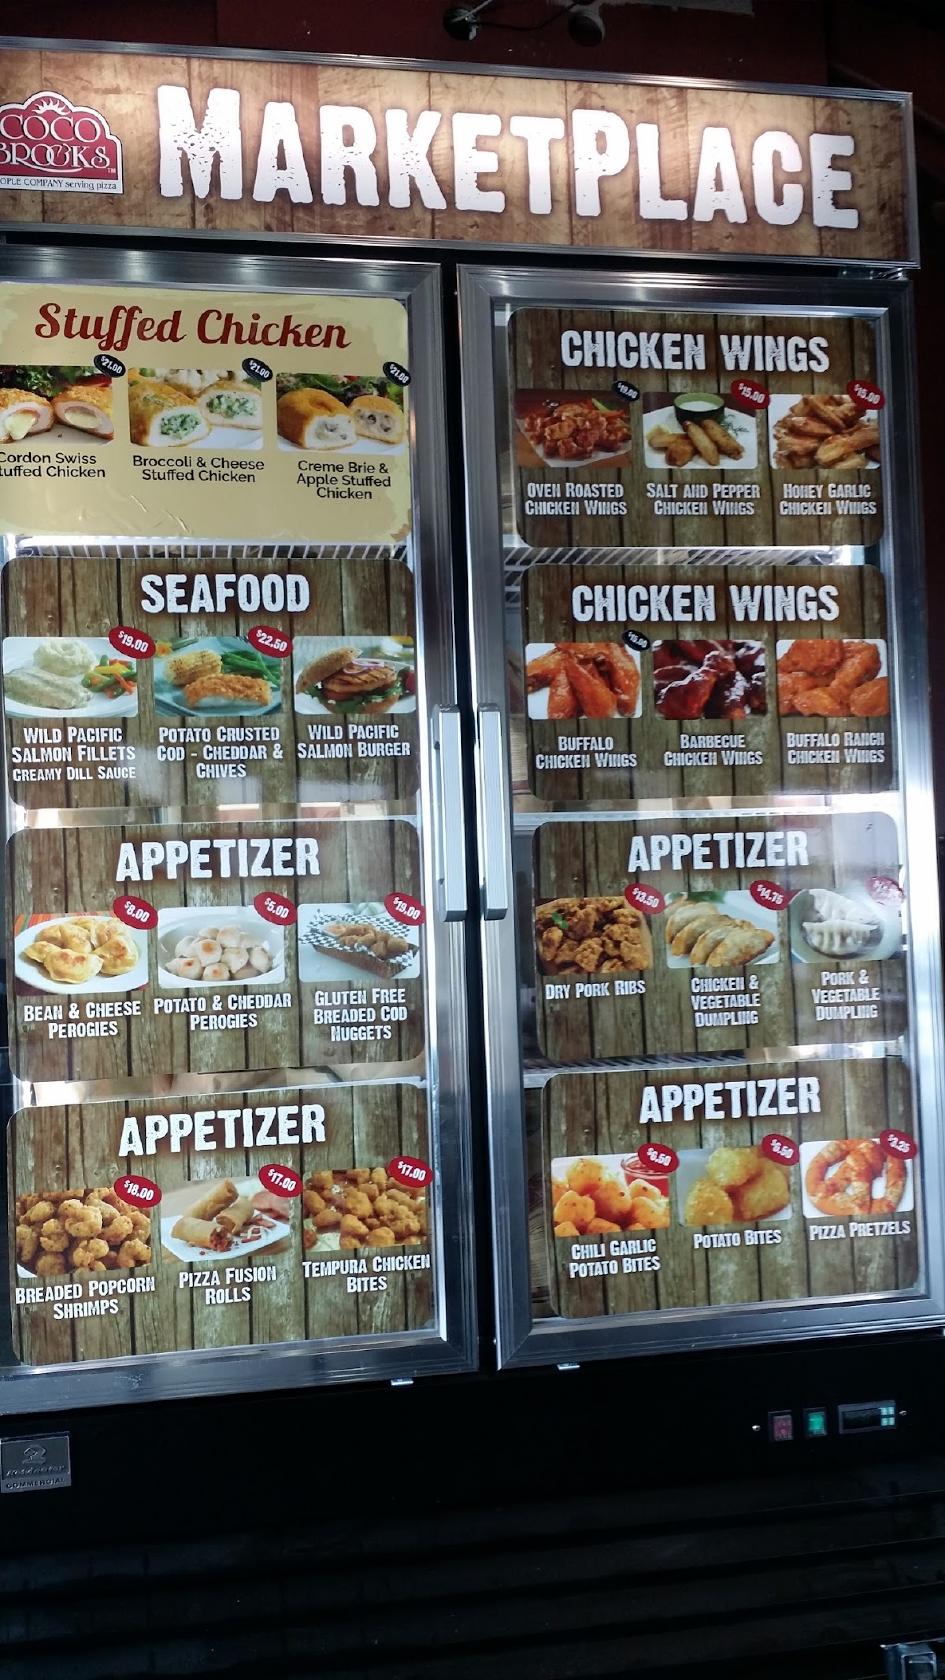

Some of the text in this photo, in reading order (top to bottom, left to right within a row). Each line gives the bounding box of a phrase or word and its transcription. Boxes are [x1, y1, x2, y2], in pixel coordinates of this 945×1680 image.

[0, 114, 101, 143] COCO
[157, 85, 859, 229] MARKETPLACE
[23, 178, 63, 188] COMPANY
[65, 181, 94, 190] serving
[97, 181, 117, 190] pizza
[35, 303, 352, 351] Stuffed Chicken
[561, 330, 830, 373] CHICKEN WINGS
[101, 355, 124, 374] $21.00
[250, 360, 271, 379] $21.00
[390, 363, 409, 384] $21.00
[738, 383, 765, 404] $15.00
[0, 451, 97, 464] Cordon Swiss
[133, 455, 265, 470] Broccoli & Cheese
[46, 466, 106, 478] Chicken
[142, 469, 256, 482] Stuffed Chicken
[298, 460, 389, 474] Creme Brie &
[296, 473, 391, 488] Apple Stuffed
[317, 487, 373, 500] Chicken
[527, 482, 624, 498] OVEN ROASTED
[646, 482, 678, 498] SALT
[712, 483, 761, 498] PEPPER
[783, 483, 871, 498] HONEY GARLIC
[525, 500, 628, 515] CHICKEN WINGS
[654, 500, 755, 515] CHICKEN WINGS
[780, 501, 877, 515] CHICKEN WINGS
[141, 573, 310, 614] SEAFOOD
[572, 584, 840, 622] CHICKEN WINGS
[117, 630, 149, 653] $19.00
[256, 630, 288, 652] $22.50
[23, 726, 122, 744] WILD PACIFIC
[159, 726, 280, 743] POTATO CRUSTED
[308, 724, 399, 740] WILD PACIFIC
[787, 731, 885, 748] BUFFALO RANCH
[298, 742, 411, 759] SALMON BURGER
[558, 736, 614, 751] BUFFALO
[680, 734, 746, 749] BARBECUE
[12, 745, 136, 763] SALMON FILLETS
[157, 746, 185, 762] COD
[203, 745, 267, 760] CHEDDAR
[273, 745, 283, 759] &
[535, 752, 638, 769] CHICKEN WINGS
[664, 751, 763, 767] CHICKEN WINGS
[787, 749, 885, 764] CHICKEN WINGS
[13, 766, 136, 782] CREAMY DILL SAUCE
[196, 763, 247, 779] CHIVES
[116, 837, 321, 882] APPETIZER
[628, 830, 810, 873] APPETIZER
[124, 901, 150, 923] $8.00
[264, 898, 290, 919] $5.00
[393, 897, 421, 920] $19.00
[691, 974, 759, 993] CHICKEN &
[820, 969, 869, 986] PORK &
[314, 988, 406, 1006] GLUTEN FREE
[545, 980, 646, 1000] DRY PORK RIBS
[811, 987, 880, 1004] VEGETABLE
[154, 993, 292, 1014] POTATO & CHEDDAR
[691, 993, 761, 1010] VEGETABLE
[24, 1001, 142, 1022] BEAN & CHEESE
[313, 1006, 408, 1025] BREADED COD
[694, 1010, 759, 1027] DUMPLING
[815, 1004, 878, 1021] DUMPLING
[48, 1021, 119, 1039] PEROGIES
[191, 1013, 258, 1031] PEROGIES
[331, 1025, 392, 1042] NUGGETS
[639, 1076, 821, 1124] APPETIZER
[118, 1104, 326, 1157] APPETIZER
[397, 1160, 426, 1181] $17.00
[267, 1169, 297, 1192] $17.00
[124, 1180, 154, 1201] $18.00
[694, 1229, 782, 1249] POTATO BITES
[809, 1220, 911, 1240] PIZZA PRETZELS
[571, 1238, 656, 1260] CHILI GARLIC
[302, 1254, 431, 1278] TEMPURA CHICKEN
[569, 1255, 661, 1278] POTATO BITES
[179, 1265, 277, 1289] PIZZA FUSION
[346, 1276, 387, 1293] BITES
[15, 1277, 155, 1304] BREADED POPCORN
[205, 1286, 251, 1305] ROLLS
[53, 1299, 119, 1320] SHRIMPS
